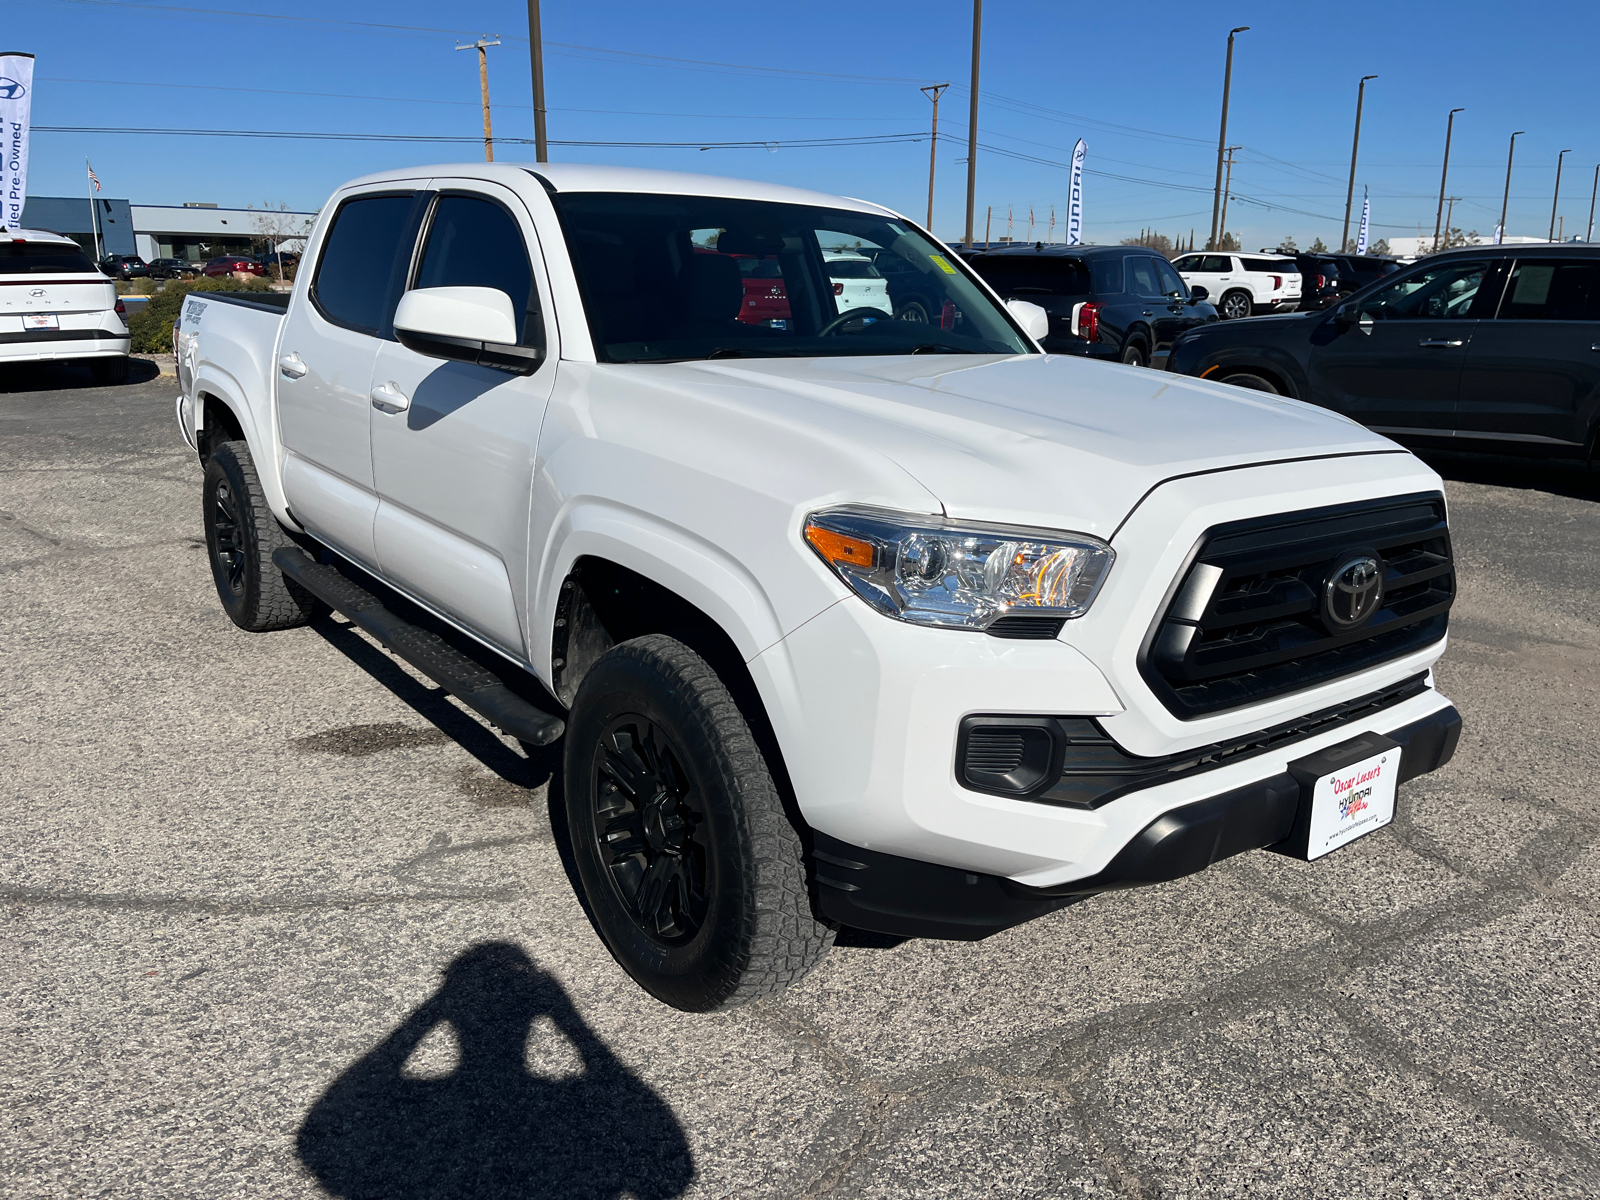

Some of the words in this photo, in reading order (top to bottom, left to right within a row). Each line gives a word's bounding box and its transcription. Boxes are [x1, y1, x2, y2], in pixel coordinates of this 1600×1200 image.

[9, 122, 21, 199] Pre-Owned
[8, 203, 20, 229] fied
[1070, 165, 1081, 246] YUNDAI
[1333, 776, 1356, 795] Oscar
[1338, 786, 1372, 810] HYUNDAI
